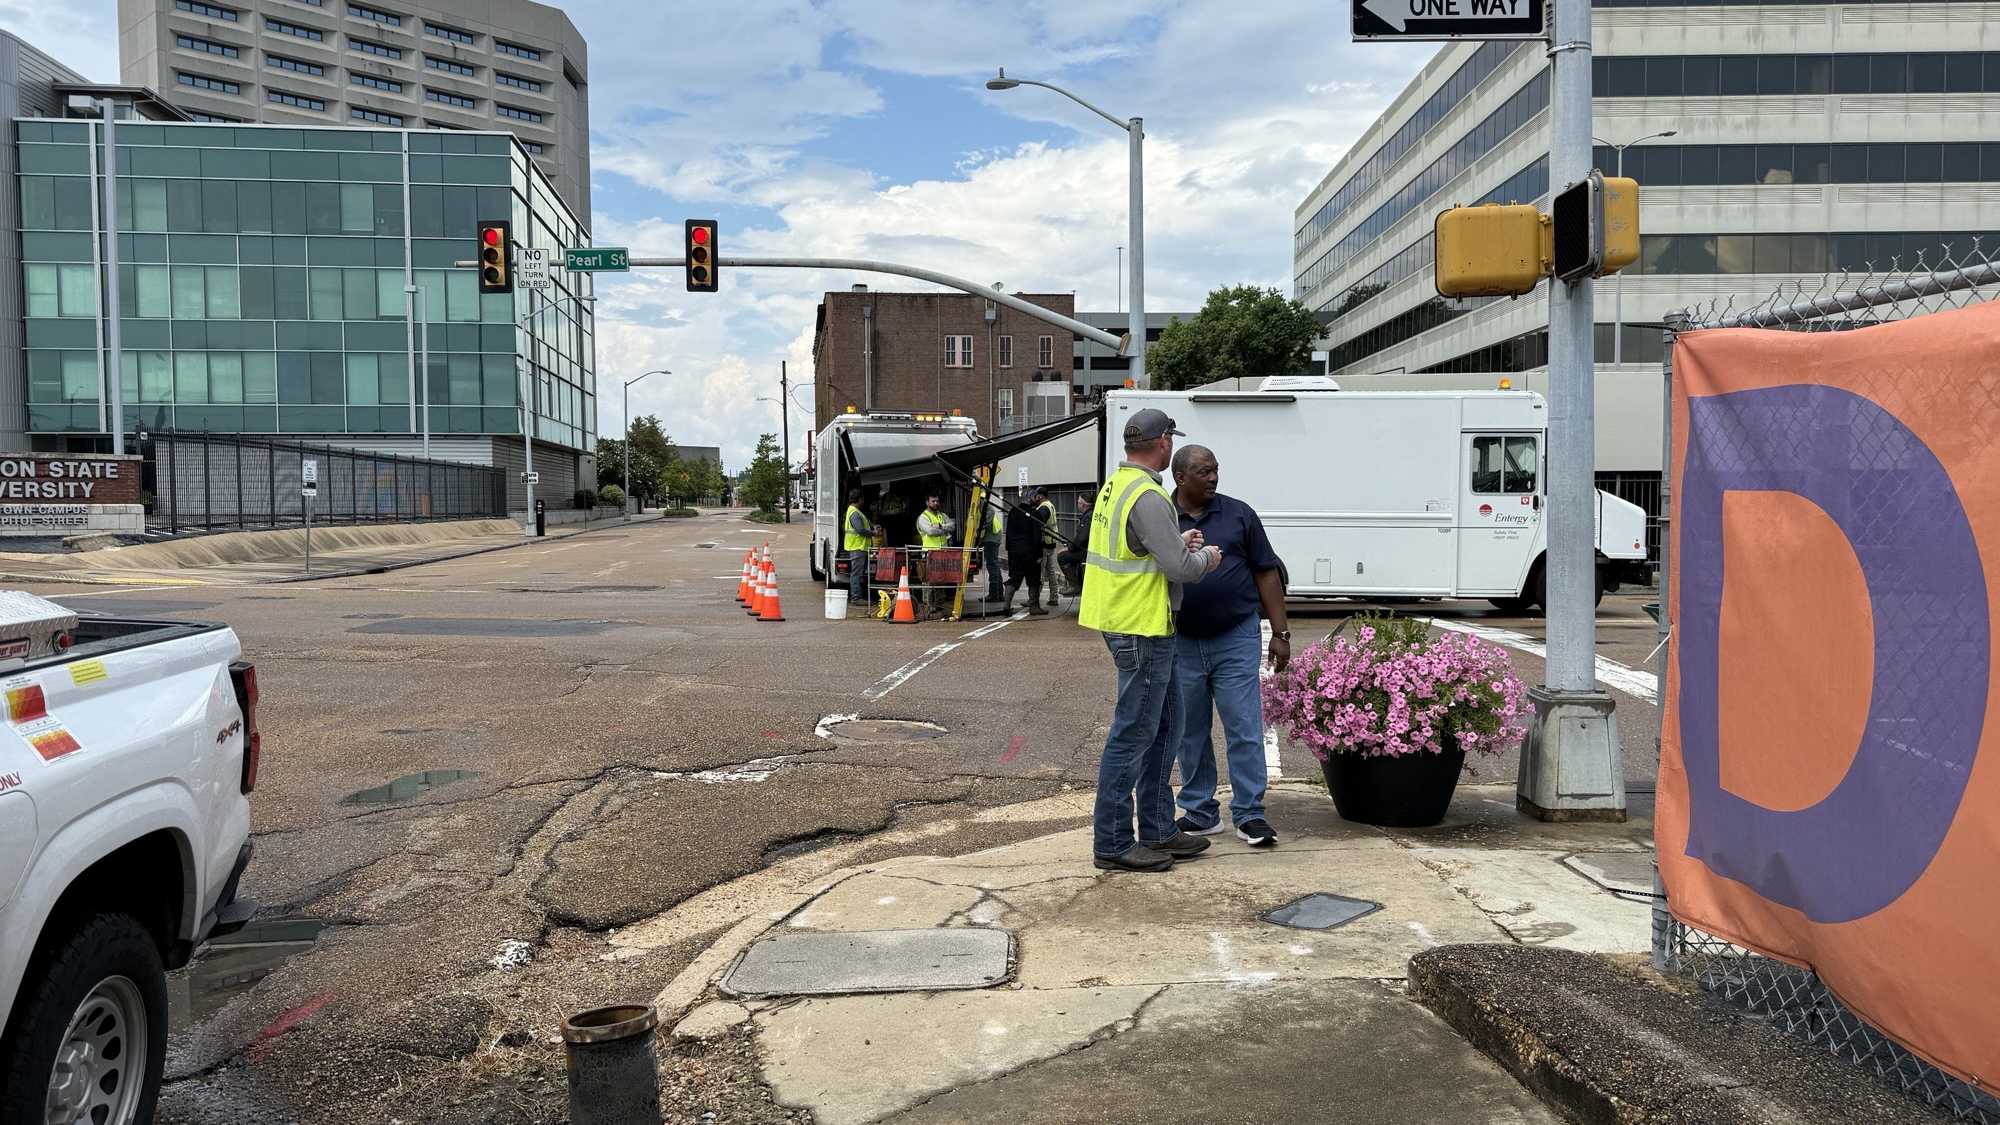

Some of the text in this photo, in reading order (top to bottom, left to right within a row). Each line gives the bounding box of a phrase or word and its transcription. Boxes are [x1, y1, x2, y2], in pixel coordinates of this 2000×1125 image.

[1409, 0, 1518, 16] ONE WAY
[524, 250, 542, 261] NO
[567, 253, 626, 267] Pearl St
[524, 262, 542, 270] LEFT
[524, 271, 544, 279] TURN
[520, 280, 548, 288] ON RED
[0, 460, 119, 479] ON STATE
[0, 505, 89, 515] OWN CAMPUS
[1494, 512, 1529, 525] Entergy
[1678, 383, 1991, 924] D
